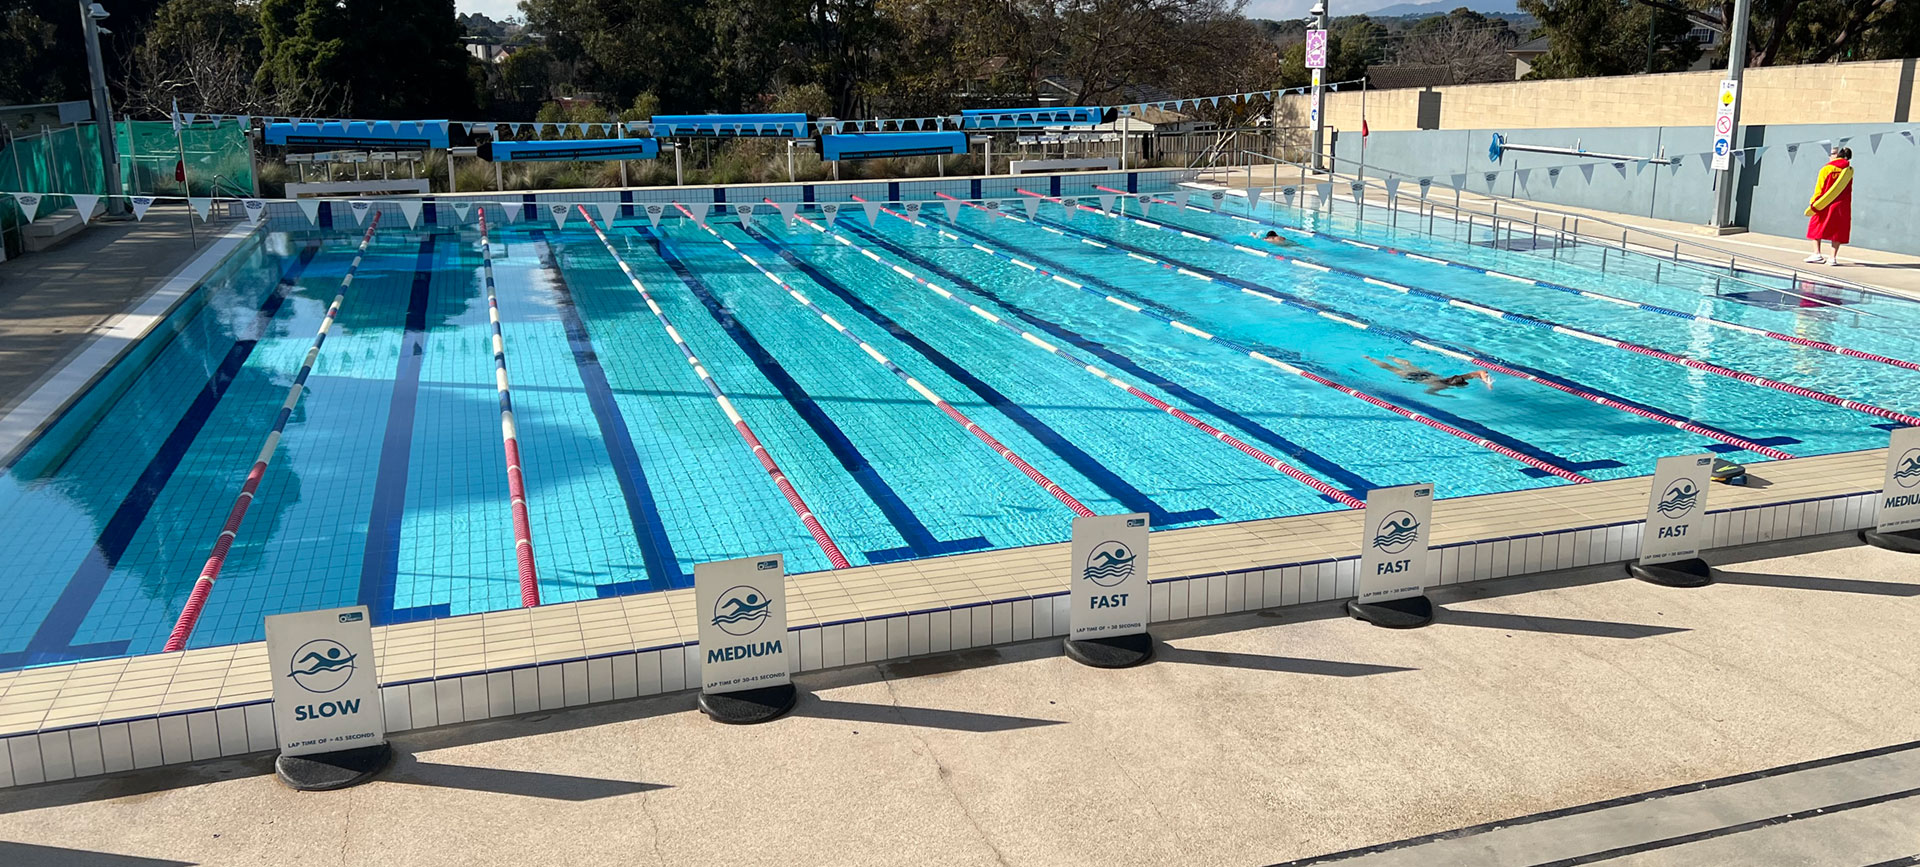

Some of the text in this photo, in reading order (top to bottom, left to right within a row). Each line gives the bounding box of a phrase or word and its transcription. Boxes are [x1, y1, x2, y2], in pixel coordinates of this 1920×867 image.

[1658, 524, 1688, 539] FAST
[1377, 559, 1411, 576] FAST
[1090, 593, 1129, 610] FAST
[707, 640, 783, 664] MEDIUM
[760, 672, 786, 680] SECONDS
[294, 698, 361, 722] SLOW
[346, 732, 376, 740] SECONDS
